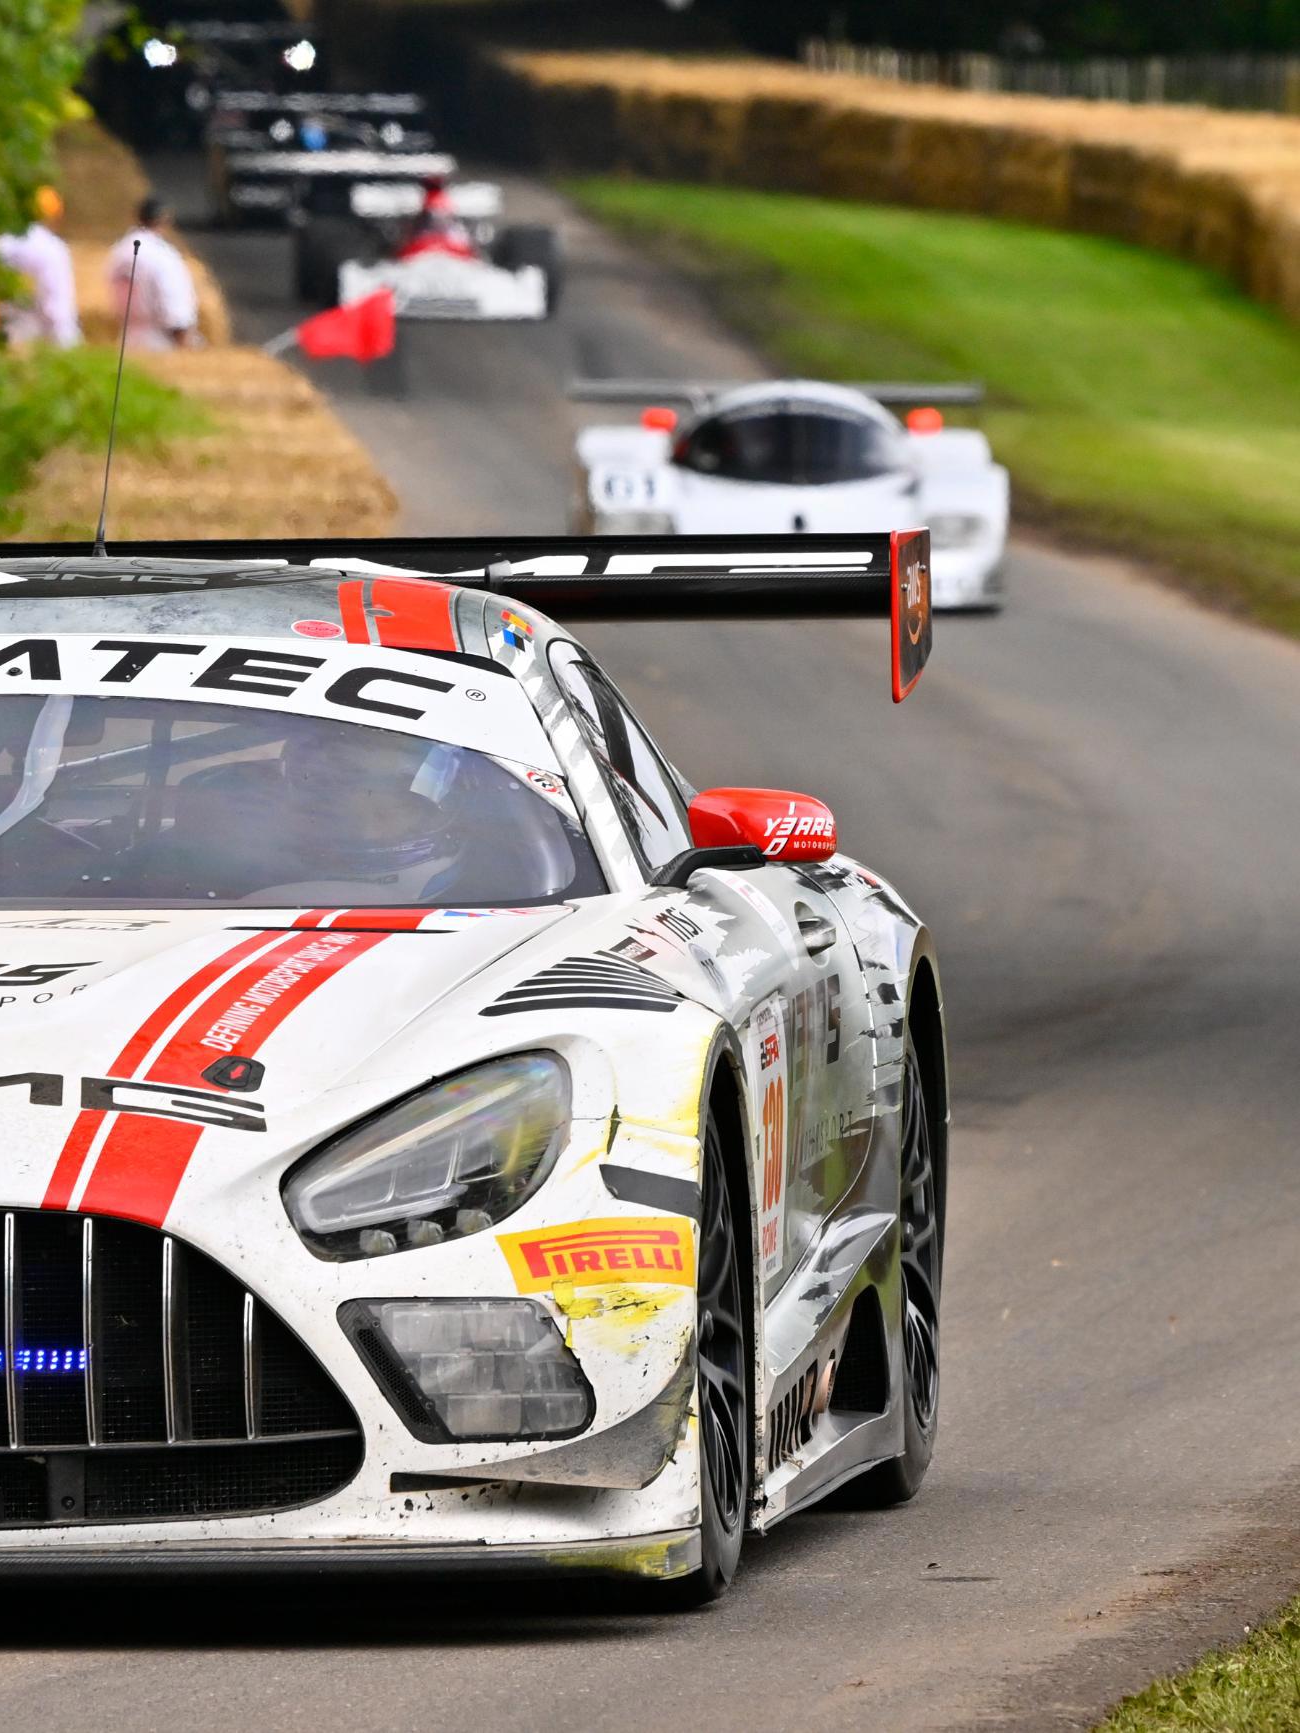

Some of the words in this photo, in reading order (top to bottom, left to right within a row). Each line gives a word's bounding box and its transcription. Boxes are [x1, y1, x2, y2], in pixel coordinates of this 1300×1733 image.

[199, 1001, 267, 1052] DEFINING
[240, 957, 317, 1007] MOTORSPORT
[295, 941, 344, 963] SINCE
[762, 1075, 784, 1213] 130
[518, 1230, 684, 1279] PIRELLI
